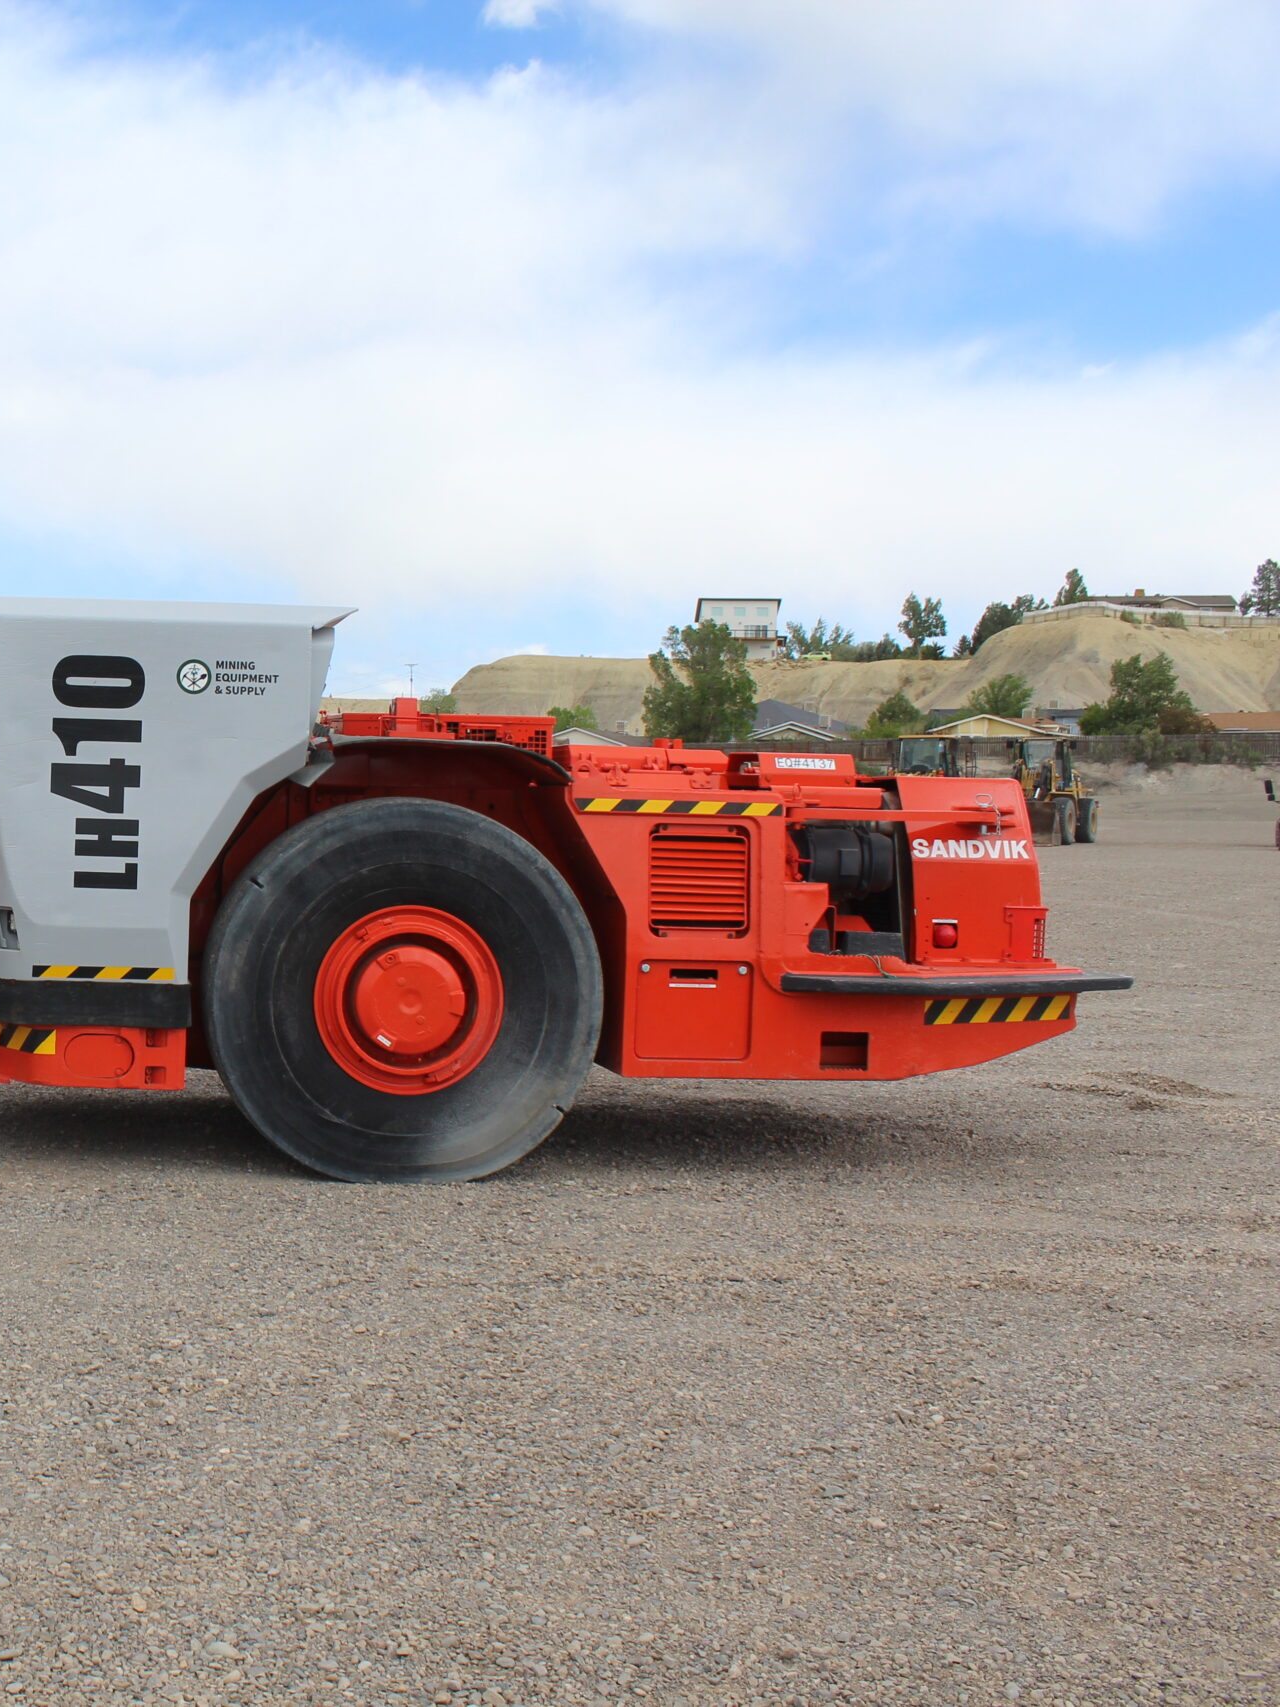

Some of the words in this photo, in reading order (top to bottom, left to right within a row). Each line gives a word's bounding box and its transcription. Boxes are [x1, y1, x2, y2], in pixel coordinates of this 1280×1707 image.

[215, 660, 256, 671] MINING
[215, 672, 279, 684] EQUIPMENT
[214, 685, 223, 695] &
[225, 685, 266, 696] SUPPLY
[777, 757, 833, 769] EQ#4137
[50, 654, 145, 890] LH410
[911, 838, 1030, 859] SANDVIK
